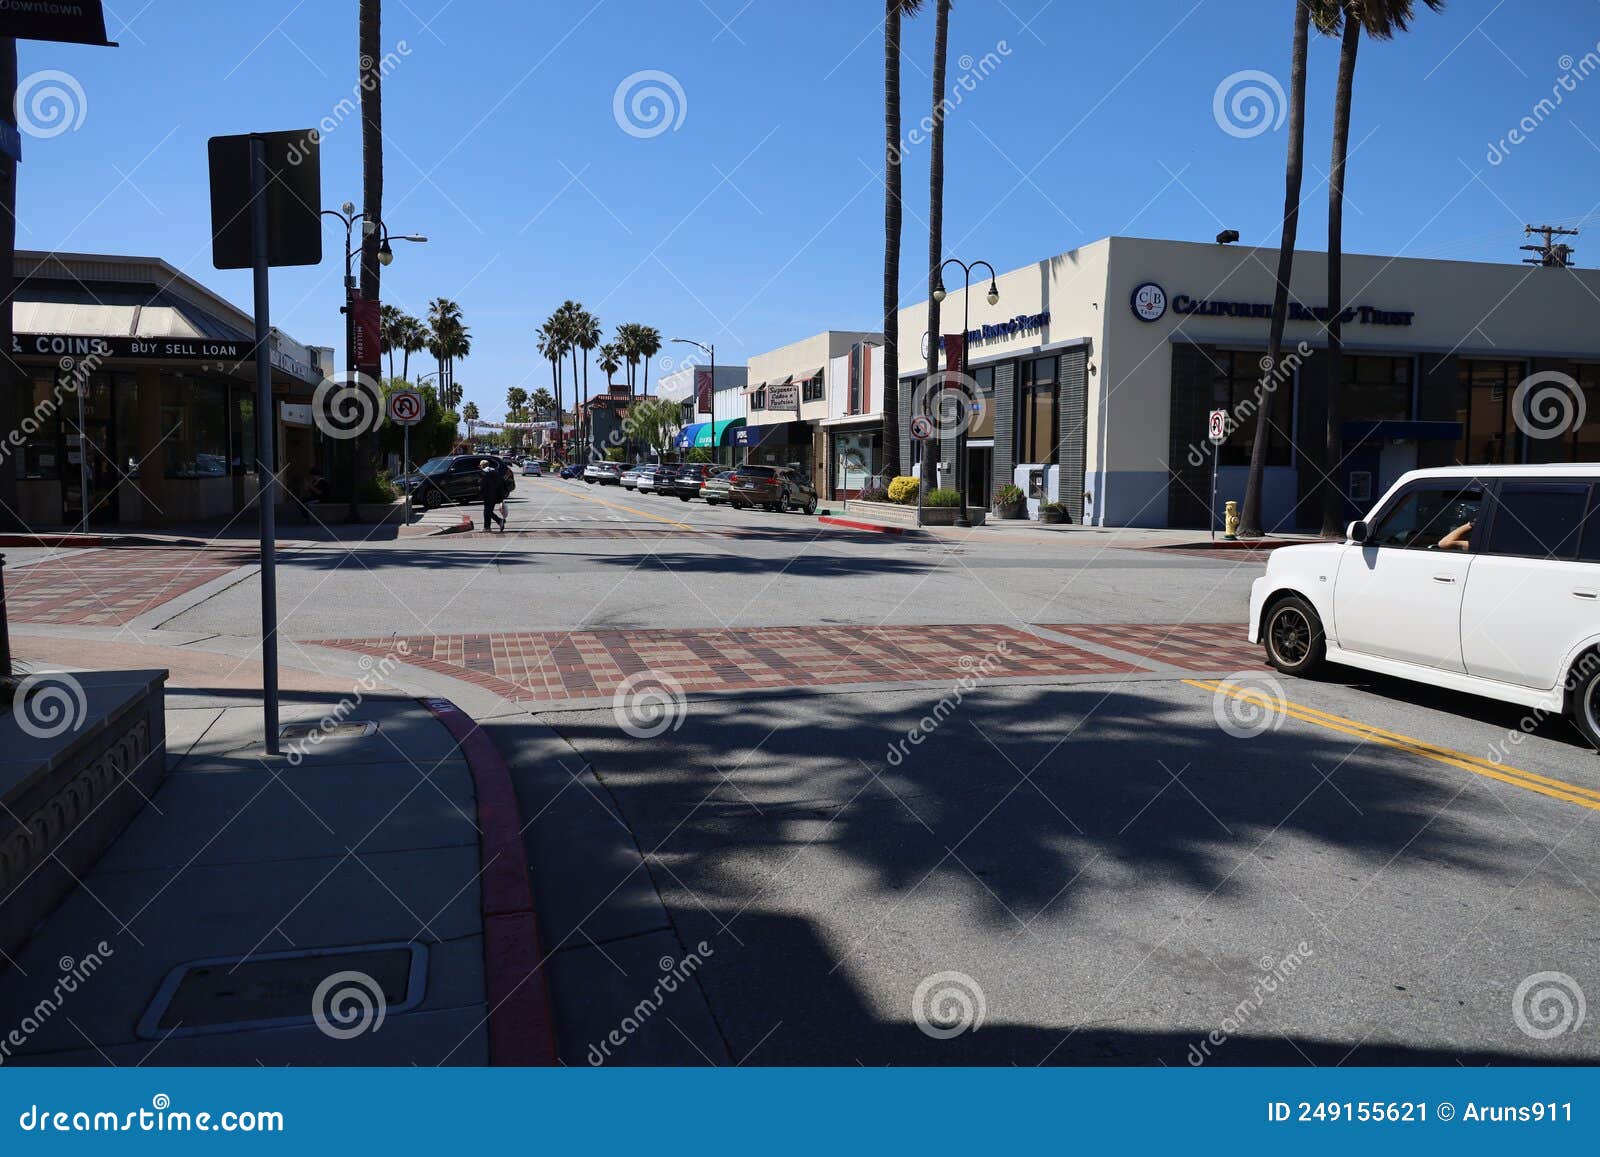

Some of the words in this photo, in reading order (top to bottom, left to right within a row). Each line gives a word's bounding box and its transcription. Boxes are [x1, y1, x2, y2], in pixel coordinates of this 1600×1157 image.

[1172, 294, 1275, 318] CALIFORNI
[35, 336, 102, 355] COINS
[131, 343, 157, 353] BUY
[165, 344, 196, 355] SELL
[203, 345, 237, 356] LOAN
